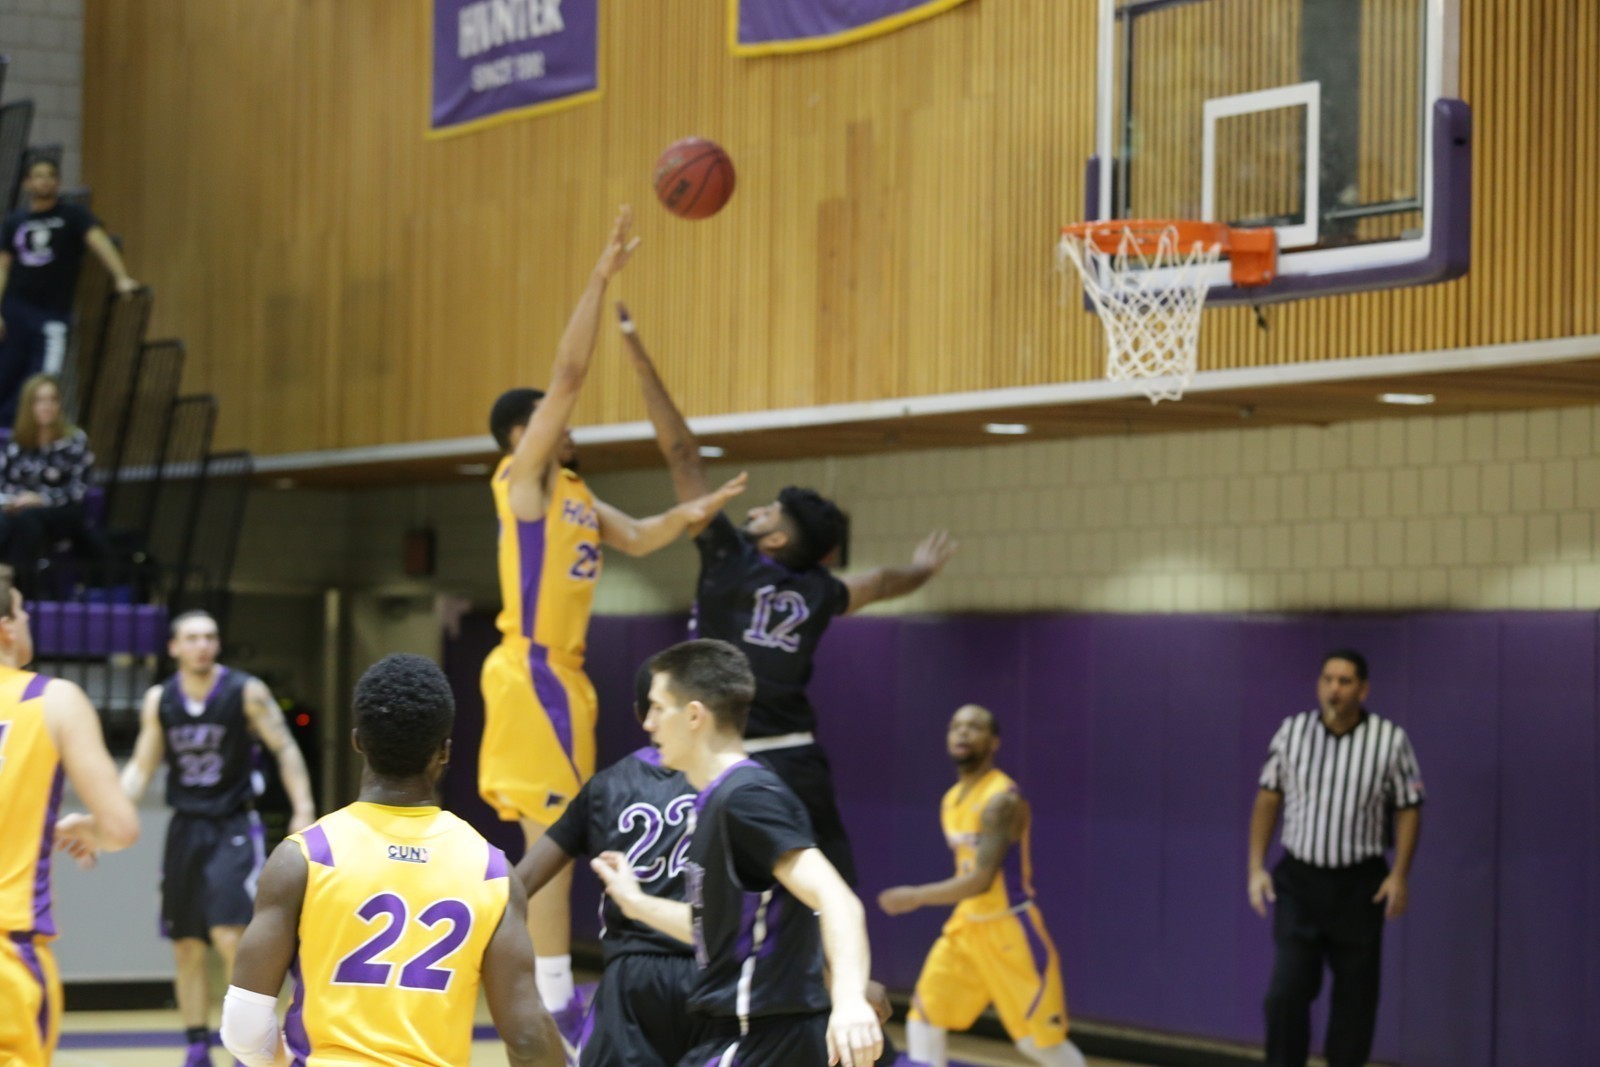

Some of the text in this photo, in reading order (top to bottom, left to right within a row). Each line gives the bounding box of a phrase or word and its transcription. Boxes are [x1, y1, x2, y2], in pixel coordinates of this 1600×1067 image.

[743, 584, 810, 653] 12
[388, 844, 428, 863] CUN
[329, 890, 474, 993] 22
